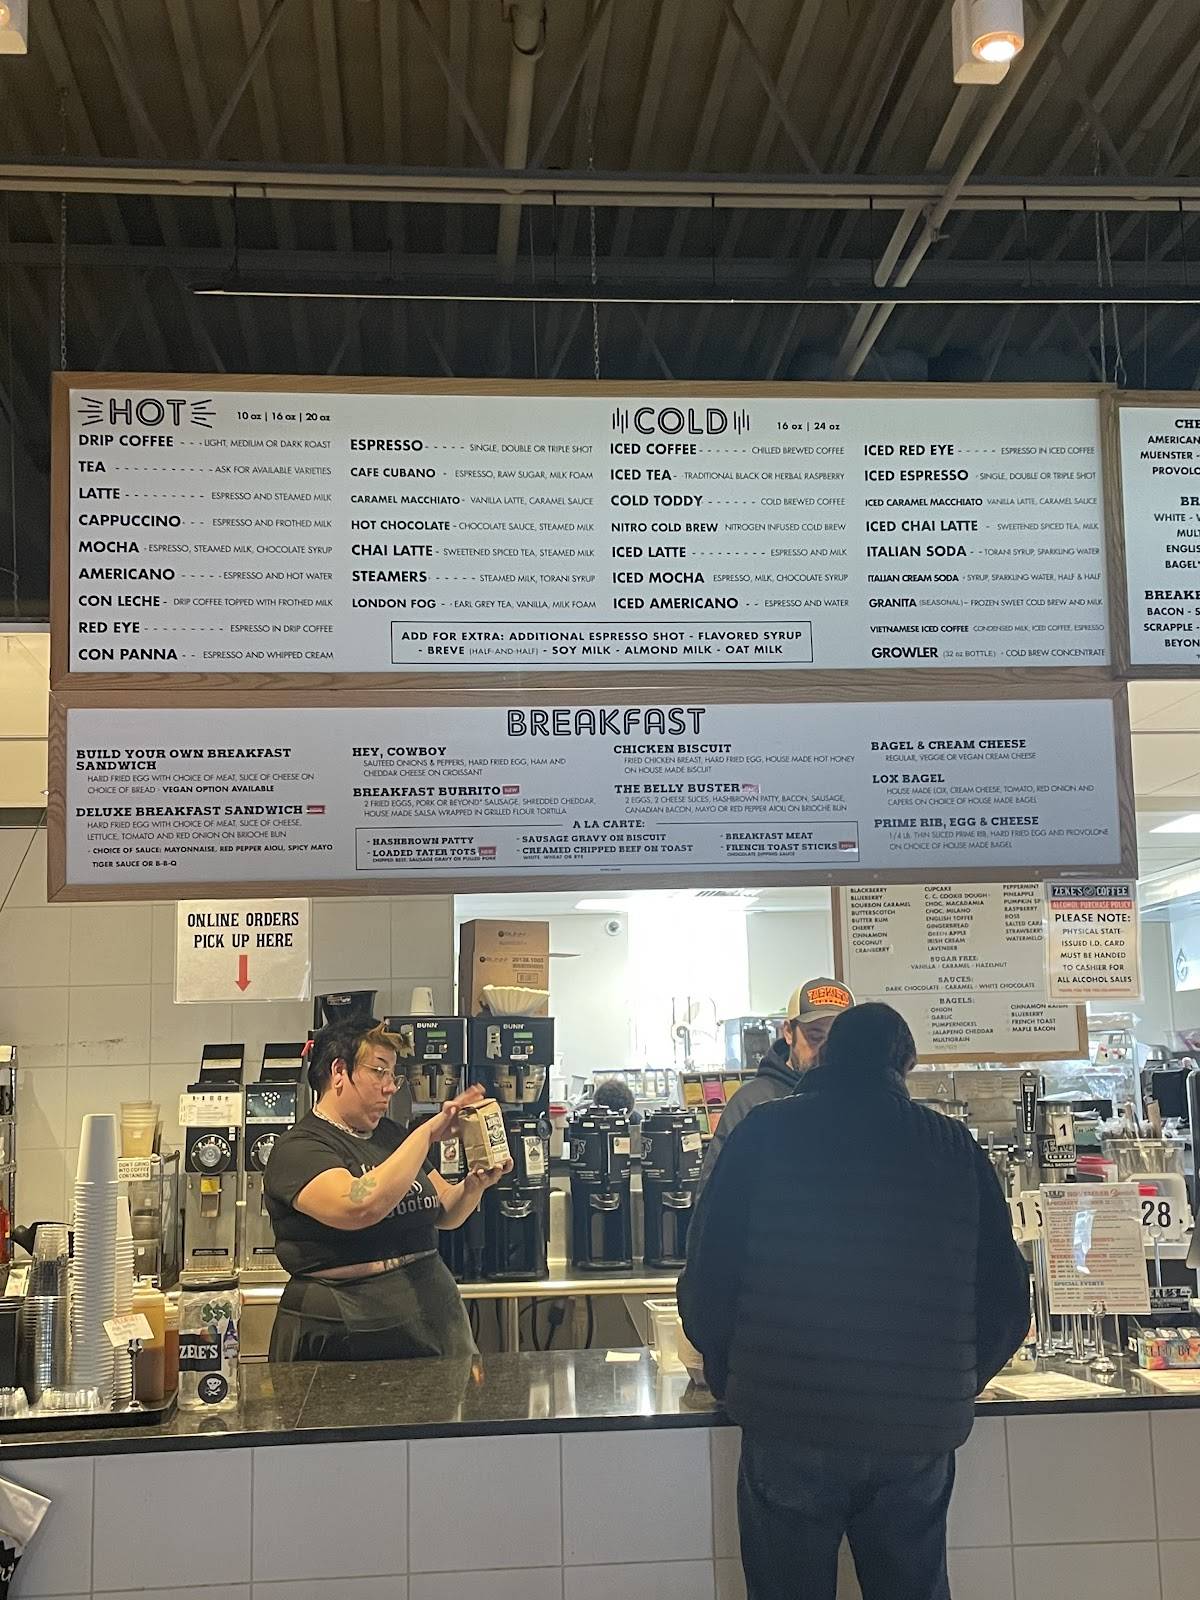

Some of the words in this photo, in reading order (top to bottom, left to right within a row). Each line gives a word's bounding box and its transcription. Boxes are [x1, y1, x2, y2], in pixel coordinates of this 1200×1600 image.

[109, 398, 187, 426] HOT
[238, 412, 248, 420] 10
[272, 412, 283, 420] 16
[634, 407, 727, 436] COLD
[778, 422, 788, 430] 16
[814, 422, 825, 430] 24
[79, 435, 113, 446] DRIP
[120, 435, 173, 446] COFFEE
[204, 439, 227, 447] LIGHT,
[281, 440, 302, 448] DARK
[351, 439, 422, 451] ESPRESSO
[611, 443, 640, 454] ICED
[646, 444, 696, 454] COFFEE
[1140, 451, 1193, 459] MUENSTER
[78, 461, 106, 472] TEA
[611, 469, 641, 480] ICED
[646, 469, 671, 480] TEA
[865, 470, 894, 481] ICED
[900, 470, 968, 480] ESPRESSO
[80, 488, 120, 499] LATTE
[212, 492, 251, 500] ESPRESSO
[275, 493, 311, 501] STEAMED
[351, 495, 397, 503] CARAMEL
[401, 496, 460, 504] MACCHIATO
[611, 495, 648, 506] COLD
[654, 496, 702, 506] TODDY
[79, 514, 180, 527] CAPPUCCINO
[1154, 514, 1186, 522] WHITE
[352, 521, 376, 530] HOT
[381, 521, 450, 530] CHOCOLATE
[459, 522, 506, 530] CHOCOLATE
[509, 523, 536, 531] SAUCE,
[540, 523, 574, 531] STEAMED
[612, 523, 647, 532] NITRO
[652, 523, 681, 532] COLD
[686, 523, 718, 532] BREW
[79, 541, 139, 552] MOCHA
[352, 545, 387, 555] CHAI
[394, 545, 432, 556] LATTE
[867, 546, 920, 556] ITALIAN
[927, 546, 966, 556] SODA
[79, 568, 174, 580] AMERICANO
[352, 571, 427, 582] STEAMERS
[79, 596, 112, 606] CON
[118, 596, 160, 606] LECHE
[614, 598, 644, 609] ICED
[650, 598, 738, 609] AMERICANO
[869, 599, 917, 607] GRANITA
[1147, 607, 1184, 615] BACON
[79, 622, 107, 633] RED
[114, 622, 139, 633] EYE
[870, 625, 919, 633] VIETNAMESE
[1143, 623, 1193, 631] SCRAPPLE
[402, 632, 427, 640] ADD
[433, 632, 456, 640] FOR
[462, 632, 503, 640] EXTRA:
[590, 632, 647, 640] ESPRESSO
[654, 632, 684, 640] SHOT
[699, 632, 758, 640] FLAVORED
[79, 649, 114, 660] CON
[120, 649, 178, 660] PANNA
[428, 646, 464, 654] BREVE
[552, 646, 576, 654] SOY
[582, 646, 610, 654] MILK
[624, 646, 678, 654] ALMOND
[683, 646, 712, 654] MILK
[725, 645, 750, 653] OAT
[755, 645, 782, 653] MILK
[872, 646, 938, 658] GROWLER
[508, 708, 705, 736] BREAKFAST
[77, 750, 120, 758] BUILD
[125, 750, 166, 758] YOUR
[170, 749, 203, 758] OWN
[208, 749, 291, 758] BREAKFAST
[352, 748, 383, 759] HEY,
[387, 747, 446, 756] COWBOY
[614, 745, 674, 754] CHICKEN
[678, 744, 731, 753] BISCUIT
[76, 761, 156, 770] SANDWICH
[873, 775, 898, 783] LOX
[902, 774, 944, 783] BAGEL
[353, 787, 434, 797] BREAKFAST
[439, 786, 500, 796] BURRITO
[614, 785, 640, 793] THE
[644, 784, 684, 793] BELLY
[688, 783, 740, 792] BUSTER
[76, 808, 132, 816] DELUXE
[136, 806, 221, 816] BREAKFAST
[225, 805, 302, 815] SANDWICH
[874, 819, 916, 828] PRIME
[920, 818, 946, 829] RIB,
[950, 818, 976, 826] EGG
[980, 817, 987, 826] &
[991, 816, 1038, 825] CHEESE
[1054, 886, 1083, 896] ZEKE'S
[1097, 886, 1128, 896] COFFEE
[188, 913, 239, 927] ONLINE
[246, 912, 298, 927] ORDERS
[1055, 913, 1094, 922] PLEASE
[1097, 913, 1131, 922] NOTE:
[194, 934, 224, 948] PICK
[232, 934, 249, 947] UP
[256, 933, 292, 947] HERE
[1059, 1123, 1067, 1136] 1
[1141, 1200, 1171, 1228] 28
